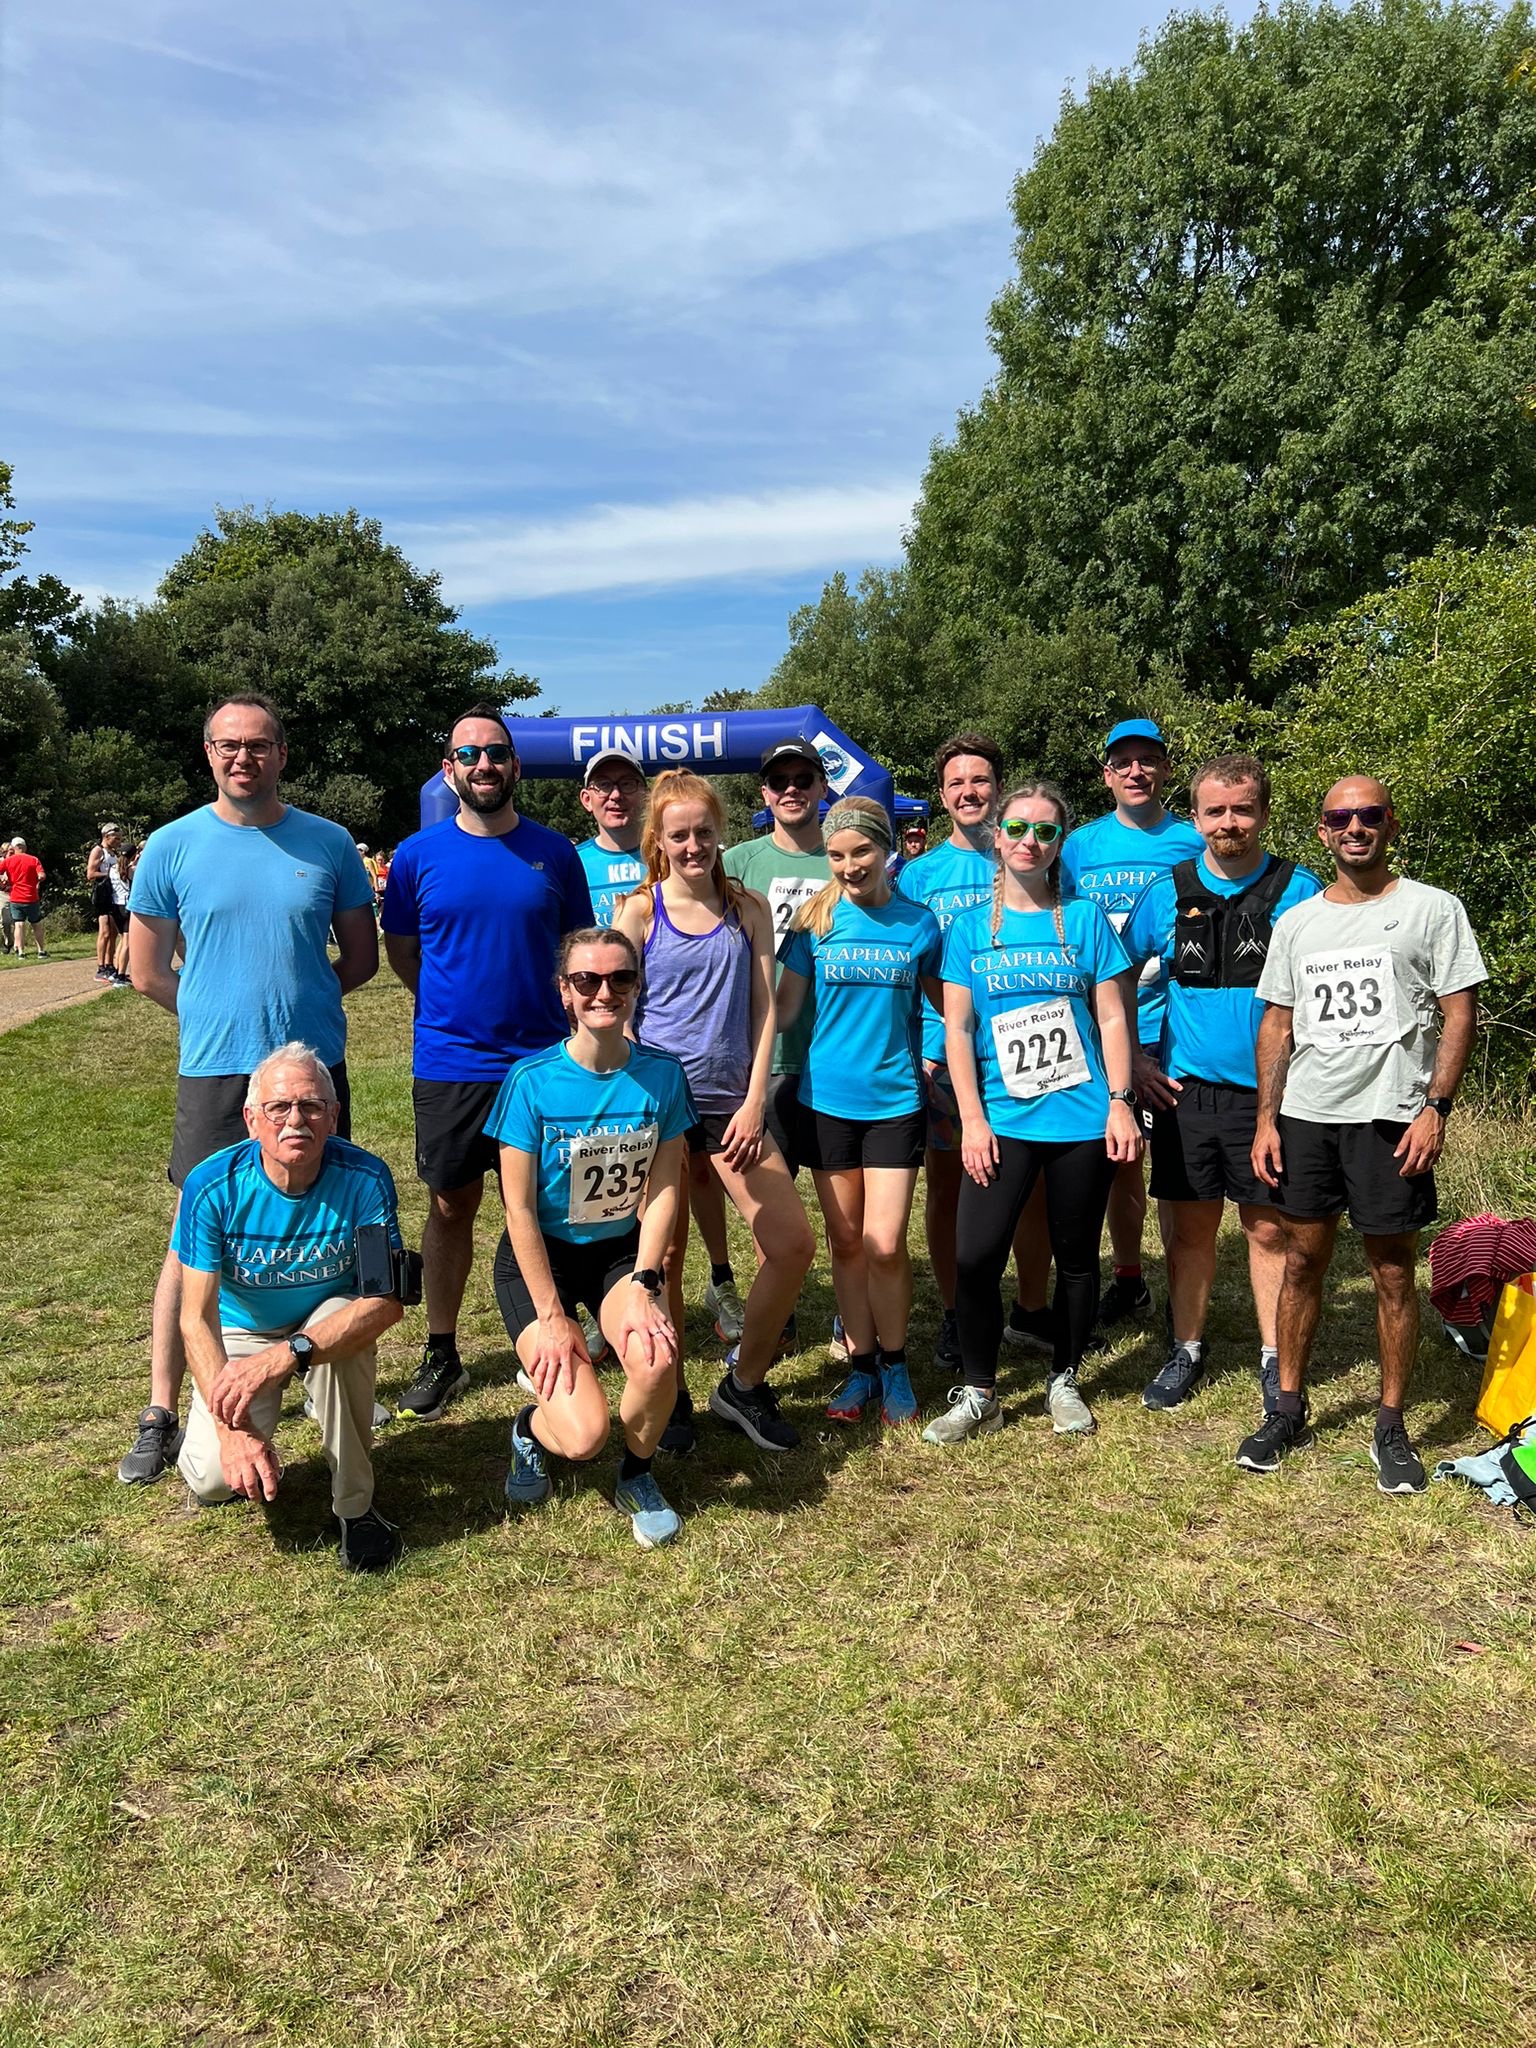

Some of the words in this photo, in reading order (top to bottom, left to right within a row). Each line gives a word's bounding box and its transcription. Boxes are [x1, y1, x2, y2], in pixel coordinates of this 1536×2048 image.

[572, 721, 723, 761] FINISH
[608, 863, 641, 883] KEN
[775, 886, 803, 896] River
[971, 951, 1077, 974] CLAPHAM
[1305, 963, 1340, 975] River
[1343, 957, 1382, 970] Relay
[986, 973, 1088, 993] RUNNERS
[1314, 977, 1382, 1022] 233
[998, 1018, 1028, 1034] River
[1031, 1008, 1065, 1025] Relay
[1008, 1027, 1073, 1075] 222
[580, 1146, 615, 1158] River
[619, 1138, 654, 1154] Relay
[584, 1157, 648, 1202] 235
